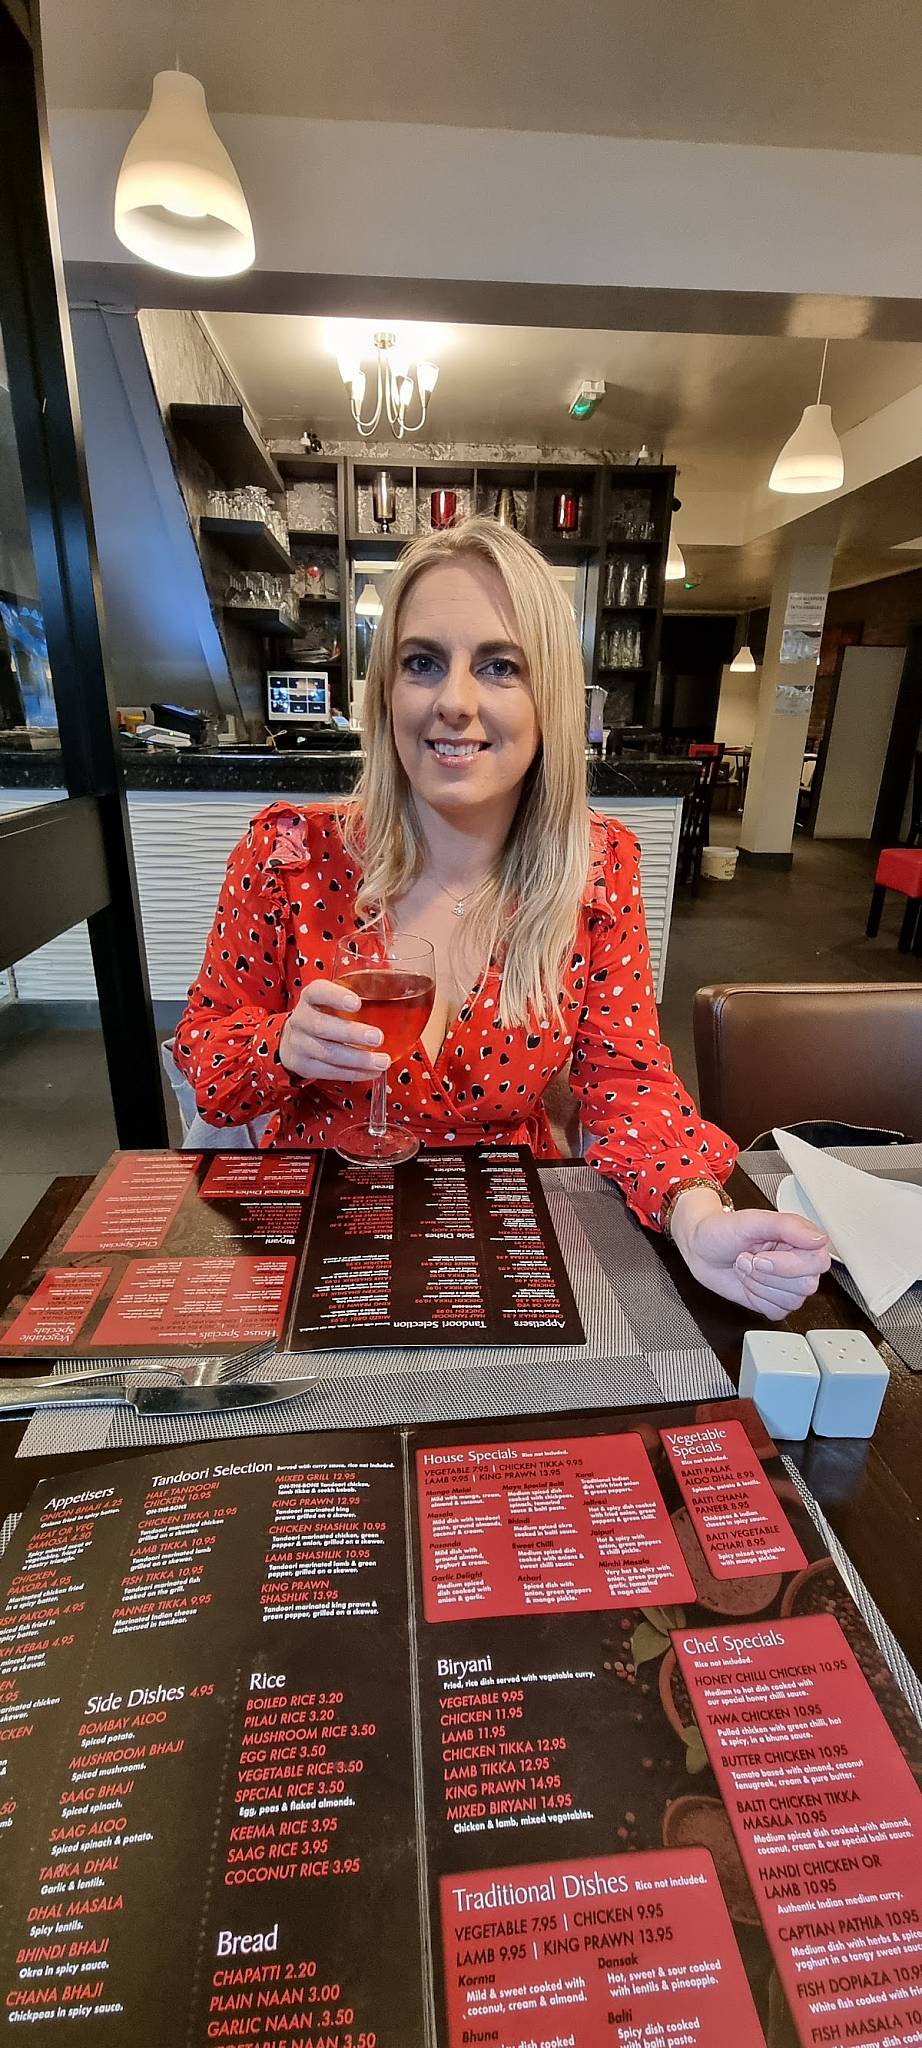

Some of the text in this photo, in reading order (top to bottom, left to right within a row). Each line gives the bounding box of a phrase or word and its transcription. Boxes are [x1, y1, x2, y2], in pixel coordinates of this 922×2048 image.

[99, 1240, 158, 1249] Chef Specials
[19, 1326, 75, 1342] Vegetable Specials
[199, 1330, 276, 1339] House Specials
[514, 1319, 565, 1328] Appetisers
[667, 1428, 727, 1448] Vegetable
[424, 1448, 518, 1465] House Specials
[672, 1440, 722, 1460] Specials
[152, 1462, 272, 1488] Tandoori Selection
[275, 1474, 304, 1483] MIXED
[424, 1467, 470, 1476] VEGETABLE
[499, 1463, 537, 1471] CHICKEN
[566, 1459, 583, 1467] 9.95
[681, 1465, 732, 1478] BALTI PALAK
[685, 1471, 755, 1486] ALOO DHAL 8.95
[40, 1499, 123, 1522] ONION BHAJI 4.25
[44, 1488, 115, 1511] Appetisers
[138, 1507, 237, 1529] CHICKEN TIKKA 10.95
[269, 1522, 386, 1534] CHICKEN SHASHLIK 10.95
[26, 1532, 92, 1550] SAMOSA 4.50
[706, 1525, 781, 1542] BALTI VEGETABLE
[710, 1538, 766, 1552] ACHARI 8.95
[7, 1576, 72, 1595] PAKORA 4.95
[112, 1594, 212, 1618] PANNER TIKKA 9.95
[683, 1630, 785, 1655] Chef Specials
[437, 1655, 492, 1679] Biryani
[695, 1660, 848, 1686] HONEY CHILLI CHICKEN 10.95
[250, 1672, 286, 1690] Rice
[84, 1684, 215, 1715] Side Dishes 4.95
[246, 1692, 344, 1711] BOILED RICE 3.20
[439, 1691, 524, 1708] VEGETABLE 9.95
[78, 1711, 167, 1737] BOMBAY ALOO
[707, 1704, 822, 1725] TAWA CHICKEN 10.95
[80, 1732, 135, 1747] Spiced potato.
[68, 1740, 184, 1769] MUSHROOM BHAJI
[238, 1760, 364, 1783] VEGETABLE RICE 3.50
[444, 1758, 550, 1781] LAMB TIKKA 12.95
[239, 1797, 356, 1817] Egg, peas & flaked almonds.
[447, 1794, 572, 1820] MIXED BIRYANI 14.95
[39, 1856, 120, 1881] TARKA DHAL
[224, 1858, 361, 1886] COCONUT RICE 3.95
[758, 1855, 883, 1881] HANDI CHICKEN OR
[41, 1884, 66, 1895] Garlic
[77, 1877, 105, 1890] lentils.
[452, 1871, 629, 1913] Traditional Dishes
[764, 1879, 837, 1899] LAMB 10.95
[777, 1891, 903, 1914] Authentic Indian medium curry.
[454, 1903, 664, 1942] VEGETABLE 7.95 CHICKEN 9.95
[778, 1909, 920, 1942] CAPTIAN PATHIA 10.95
[16, 1938, 109, 1963] BHINDI BHAJI
[217, 1924, 279, 1956] Bread
[456, 1927, 673, 1967] LAMB 9.95 KING PRAWN 13.95
[19, 1960, 109, 1979] Okra in spicy sauce.
[598, 1953, 639, 1970] Dansak
[212, 1961, 317, 1987] CHAPATTI 2.20
[797, 1972, 891, 1998] FISH DOPIAZA
[5, 1982, 104, 2007] CHANA BHAJI
[466, 1977, 585, 2002] Mild & sweet cooked with
[207, 2017, 262, 2037] GARLIC
[265, 2012, 313, 2032] NAAN
[608, 2009, 633, 2024] Balti
